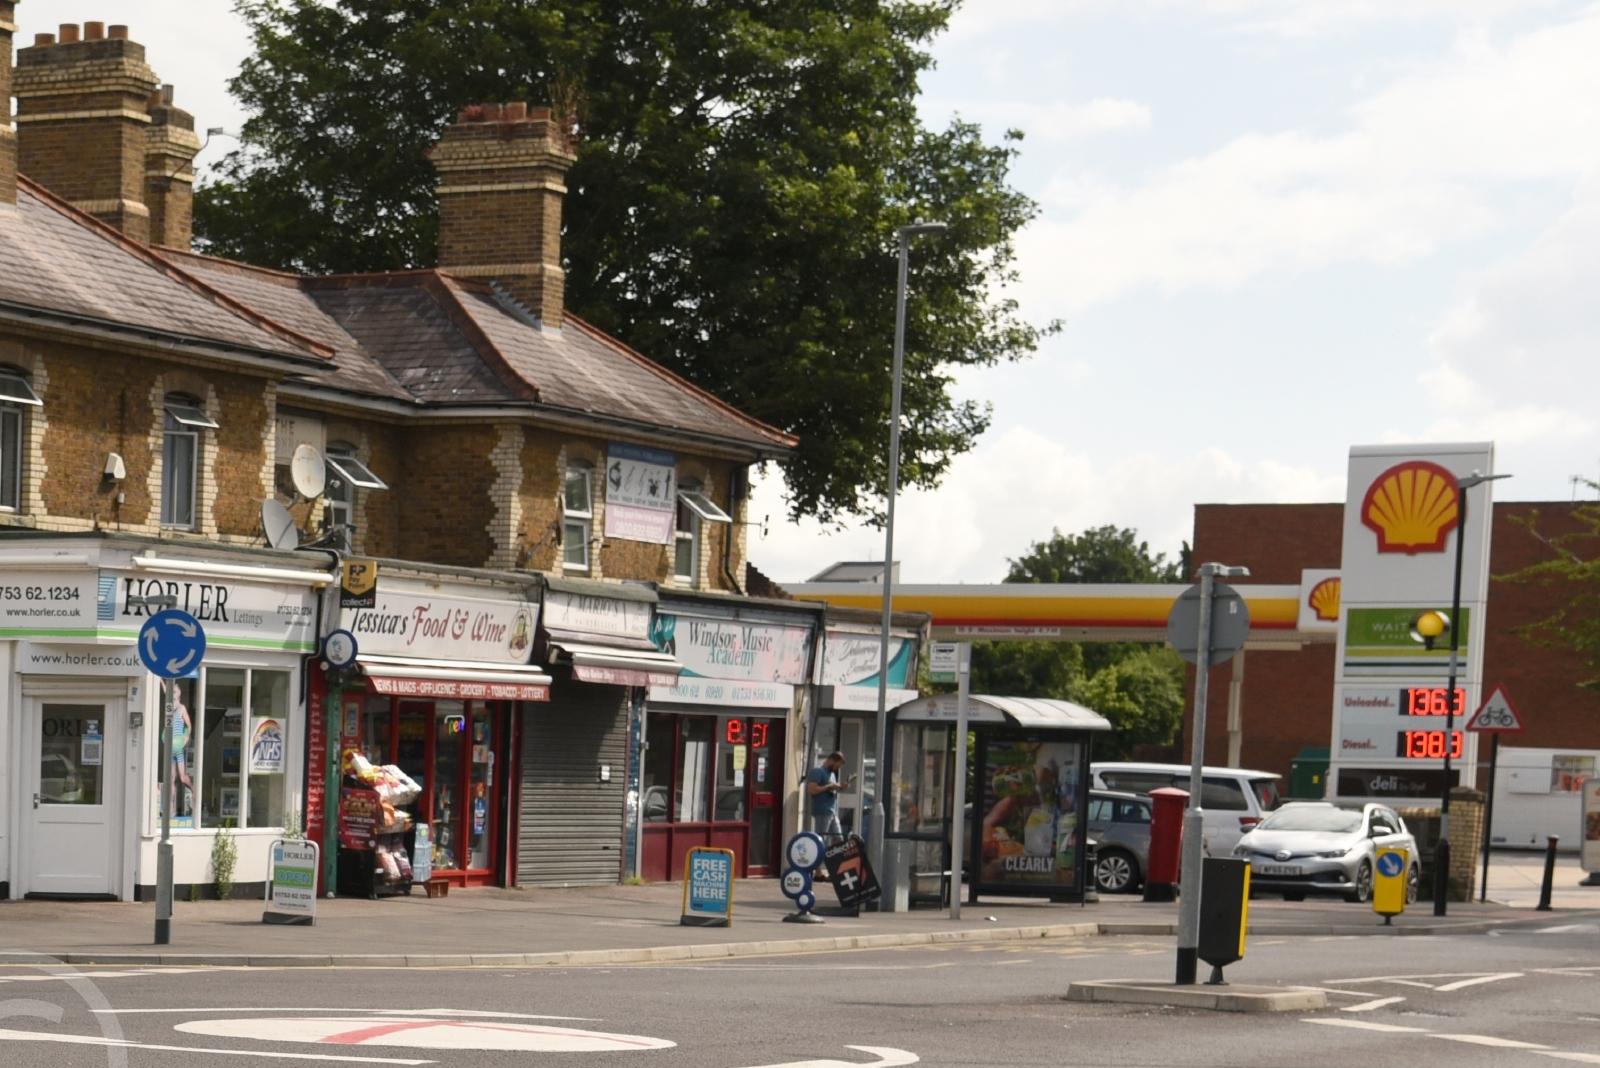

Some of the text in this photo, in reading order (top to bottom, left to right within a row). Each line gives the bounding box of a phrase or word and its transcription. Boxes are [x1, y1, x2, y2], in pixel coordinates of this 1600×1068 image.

[25, 587, 80, 600] 62.1234
[6, 607, 81, 617] www.horler.co.uk
[233, 610, 264, 628] Lettings
[351, 603, 507, 645] Jessica's Food & Wine
[689, 621, 773, 651] Windsor Music
[31, 652, 141, 666] www.horler.co.uk
[706, 648, 758, 667] Academy
[521, 687, 545, 698] LOTTERY
[259, 740, 281, 760] NHS
[1370, 776, 1398, 791] deli
[693, 858, 727, 872] FREE
[1005, 857, 1055, 873] CLEARLY
[277, 870, 312, 883] OPEN
[693, 870, 727, 882] CASH
[693, 887, 727, 900] HERE
